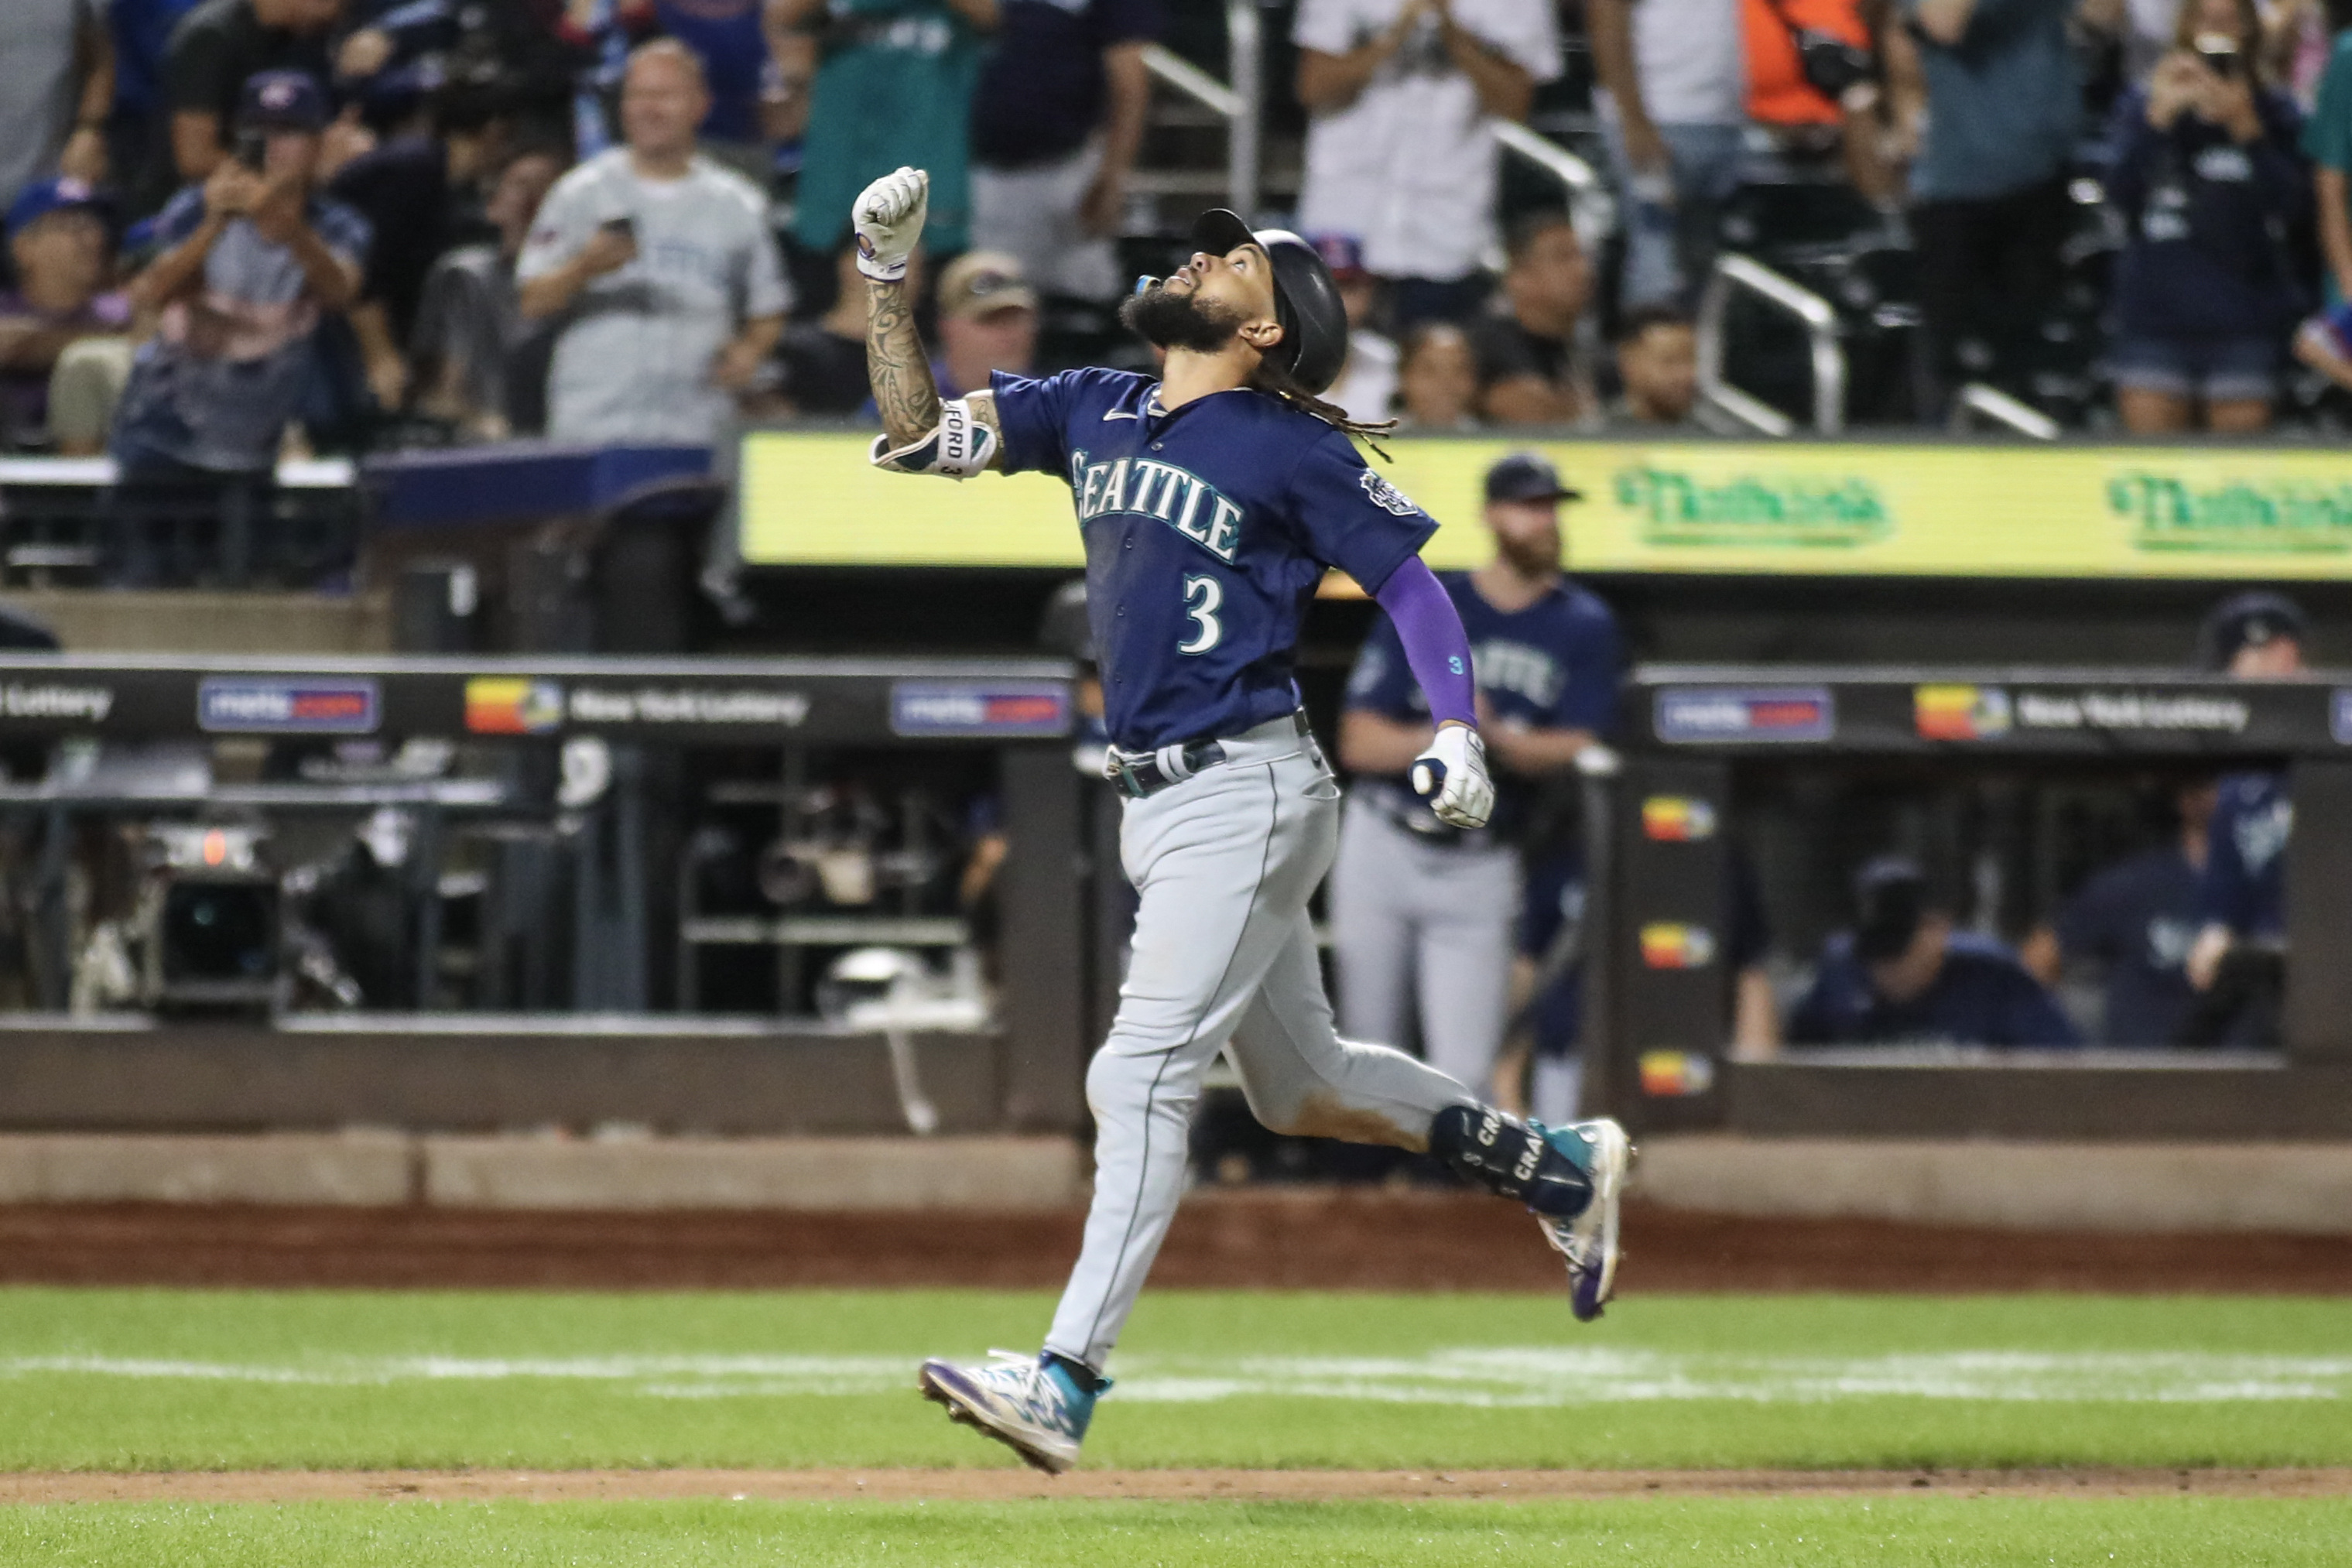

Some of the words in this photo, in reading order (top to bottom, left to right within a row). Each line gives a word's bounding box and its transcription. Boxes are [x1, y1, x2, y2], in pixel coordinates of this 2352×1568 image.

[944, 404, 964, 459] FORD
[1072, 449, 1243, 565] SEATTLE
[1178, 573, 1224, 656] 3
[1448, 656, 1464, 676] 3
